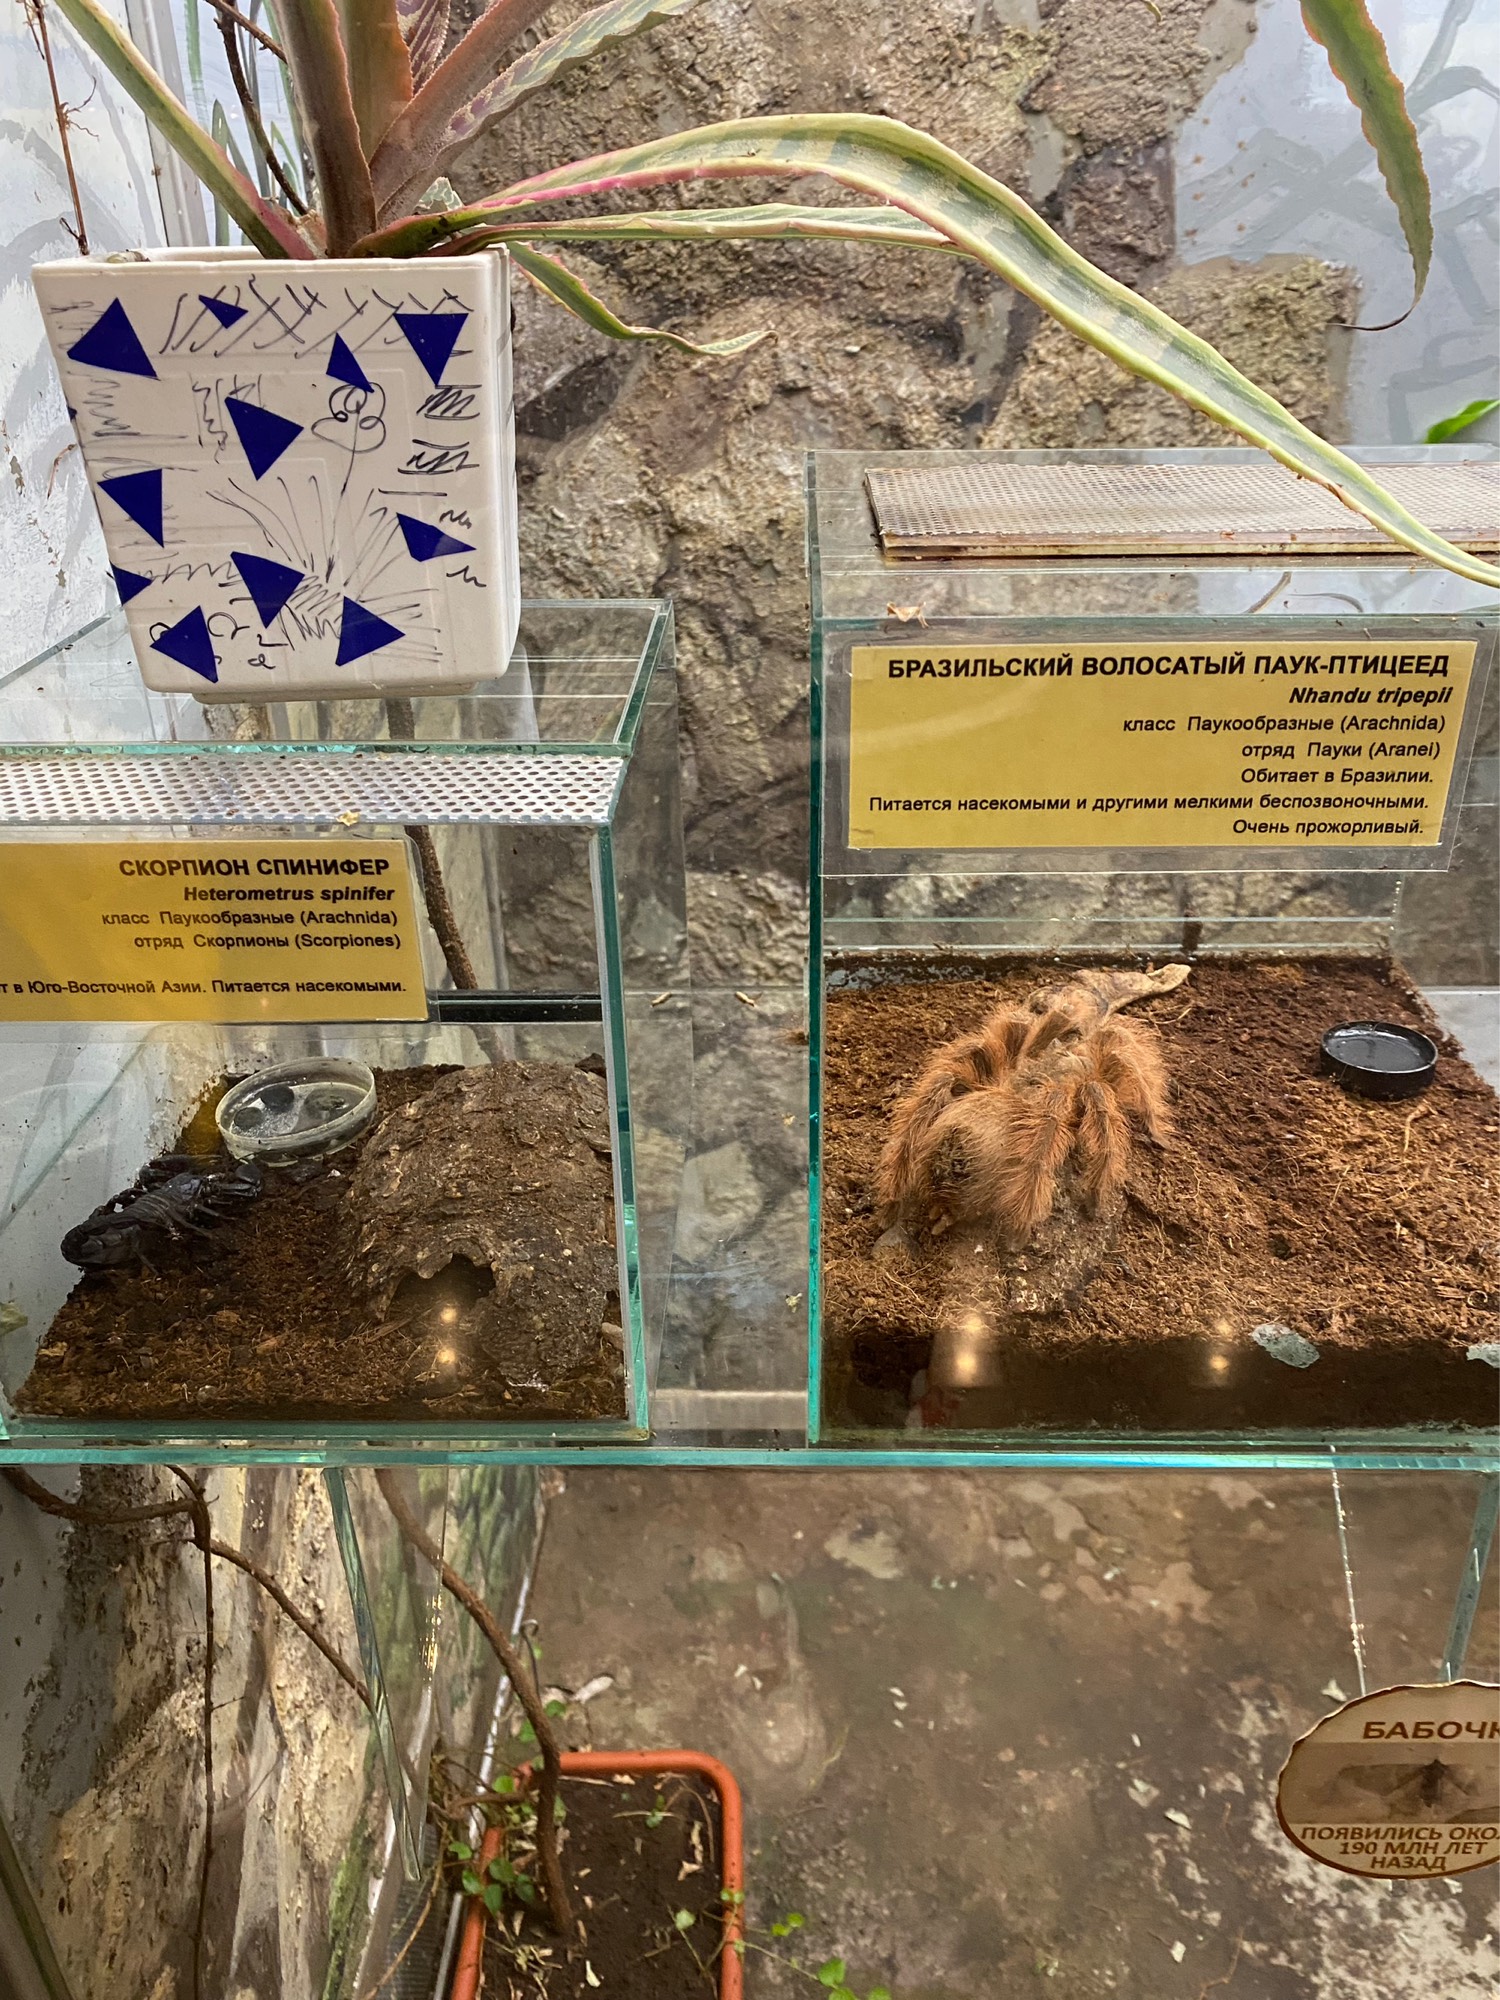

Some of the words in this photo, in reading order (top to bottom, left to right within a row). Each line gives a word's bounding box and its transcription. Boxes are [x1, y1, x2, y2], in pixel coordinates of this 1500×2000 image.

[889, 653, 1073, 678] БРАЗИЛЬСКИЙ
[1082, 651, 1245, 675] ВОЛОСАТЫЙ
[1254, 654, 1449, 677] ПАУК-ПТИЦЕЕД
[1289, 687, 1371, 703] Nhandu
[1377, 687, 1453, 707] tripepii
[1124, 720, 1175, 731] класс
[1188, 716, 1334, 734] Паукообразные
[1341, 715, 1445, 733] (Arachnida)
[1242, 745, 1294, 760] отряд
[1308, 742, 1362, 760] Пауки
[1369, 742, 1440, 760] (Aranei)
[1241, 768, 1319, 783] Обитает
[1324, 772, 1334, 782] в
[1341, 768, 1432, 786] Бразилии.
[870, 797, 951, 811] Питается
[958, 799, 1070, 810] насекомыми
[1077, 799, 1087, 809] и
[1092, 798, 1168, 812] другими
[1174, 797, 1253, 808] мелкими
[1260, 794, 1428, 808] беспозвоночными.
[1233, 819, 1289, 833] Очень
[1296, 819, 1423, 837] прожорливый.
[120, 859, 250, 876] СКОРПИОН
[257, 859, 389, 875] СПИНИФЕР
[184, 887, 314, 901] Heterometrus
[320, 886, 395, 903] spinifer
[102, 914, 150, 924] класс
[160, 911, 294, 927] Паукообразные
[300, 911, 397, 927] (Arachnida)
[134, 937, 184, 950] отряд
[194, 934, 289, 950] Скорпионы
[295, 934, 400, 949] (Scorpiones)
[13, 984, 23, 993] в
[28, 981, 155, 993] Юго-Восточной
[162, 981, 206, 992] Азии.
[212, 980, 290, 992] Питается
[296, 982, 406, 992] насекомыми.
[1300, 1826, 1443, 1840] ПОЯВИЛИСЬ
[1449, 1827, 1500, 1840] ОКО
[1339, 1841, 1378, 1855] 190
[1383, 1841, 1439, 1854] МЛН
[1443, 1841, 1489, 1854] ЛЕТ
[1370, 1856, 1448, 1871] НАЗАД
